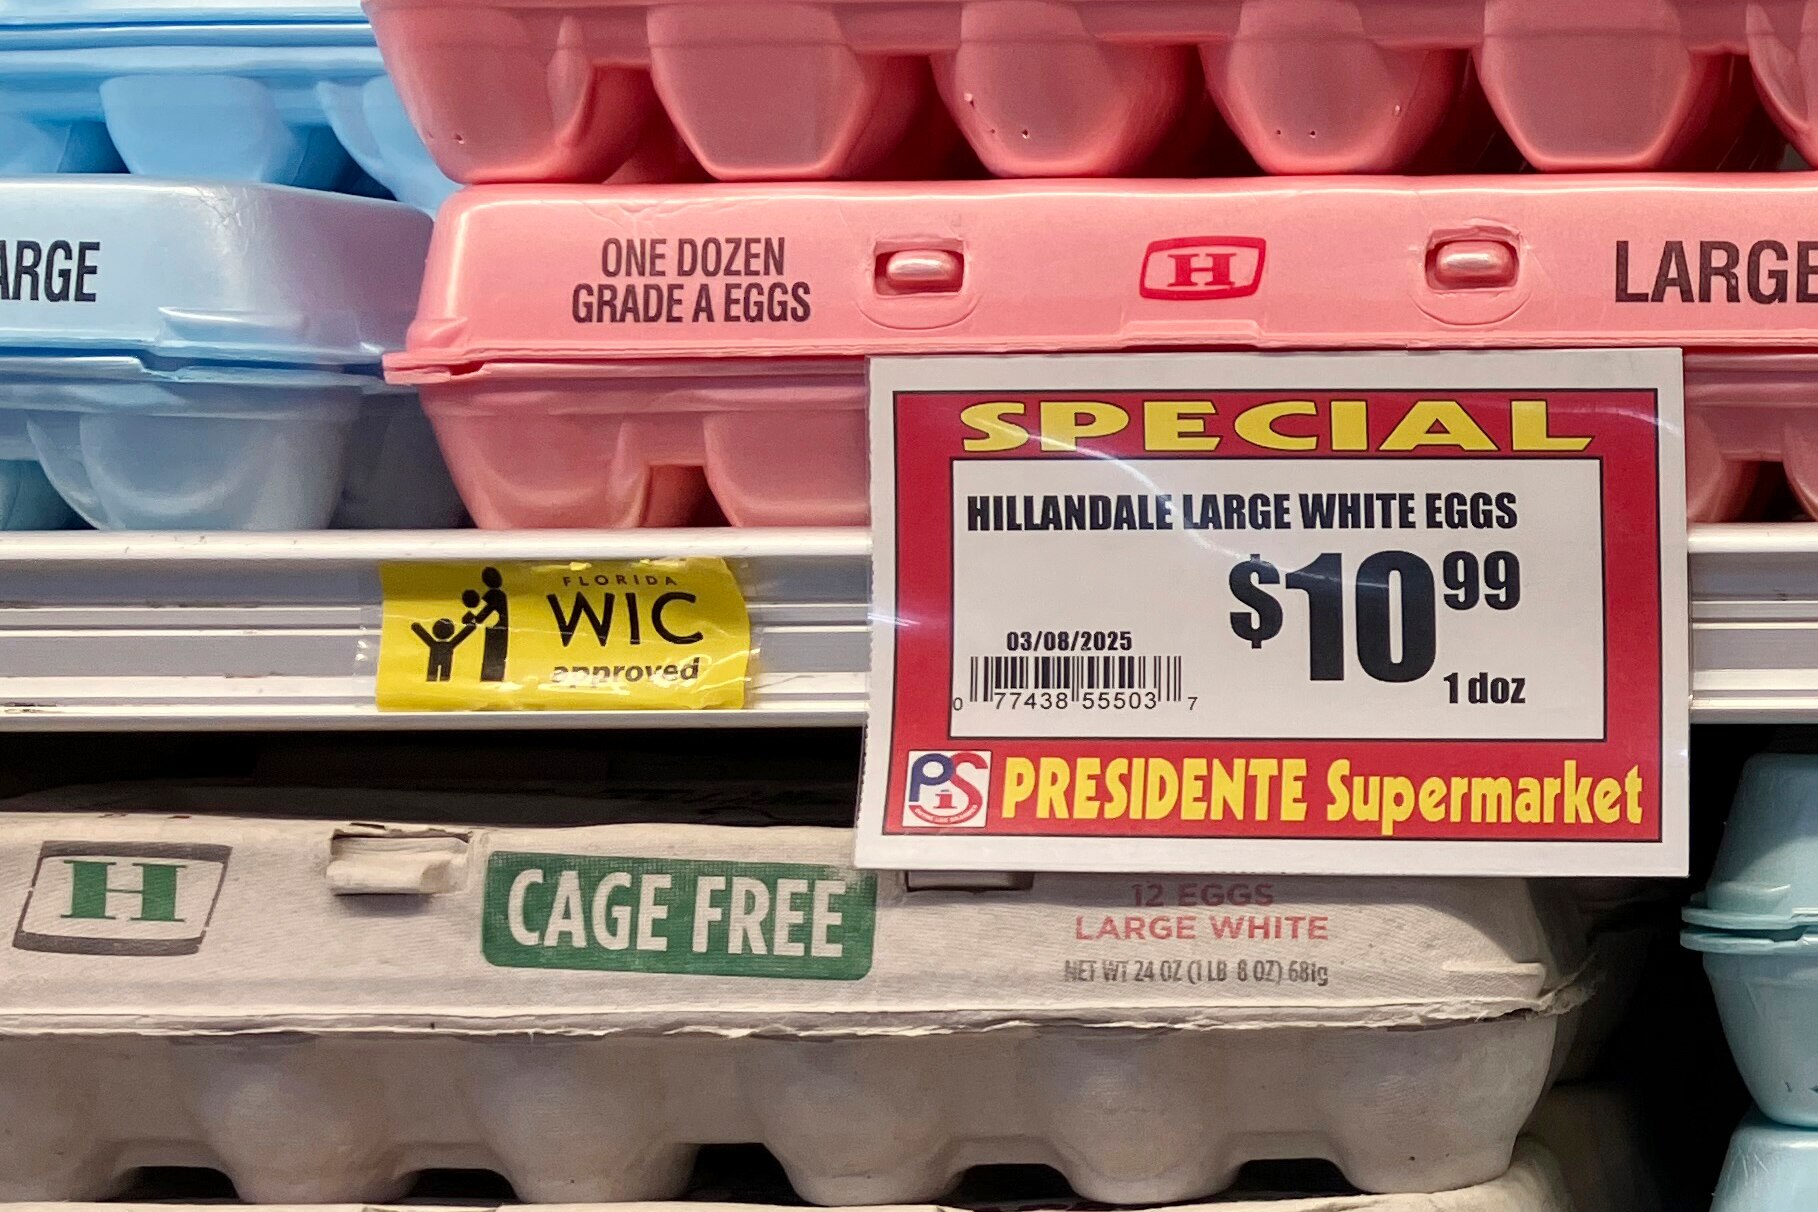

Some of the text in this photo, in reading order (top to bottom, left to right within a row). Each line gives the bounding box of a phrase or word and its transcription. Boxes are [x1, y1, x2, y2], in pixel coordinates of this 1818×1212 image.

[601, 237, 785, 277] ONE DOZEN
[1167, 253, 1237, 287] H
[572, 281, 811, 323] GRADE A EGGS
[959, 400, 1594, 453] SPECIAL
[967, 492, 1518, 531] HILLANDALE LARGE WHITE EGGS
[563, 575, 677, 587] FLORIDA
[546, 591, 704, 647] WIC
[1006, 631, 1133, 651] 03/08/2025
[552, 657, 701, 688] approved
[1443, 674, 1526, 705] 1 doz
[953, 692, 1198, 711] 0 77438 55503 7
[1002, 758, 1644, 835] PRESIDENTE Supermarket
[61, 858, 186, 922] H
[1131, 882, 1275, 907] 12 EGGS
[507, 869, 846, 958] CAGE FREE
[1074, 914, 1329, 941] LARGE WHITE
[1135, 959, 1156, 984] 24
[1160, 959, 1182, 984] OZ
[1207, 959, 1227, 983] LB
[1288, 960, 1329, 987] 681g
